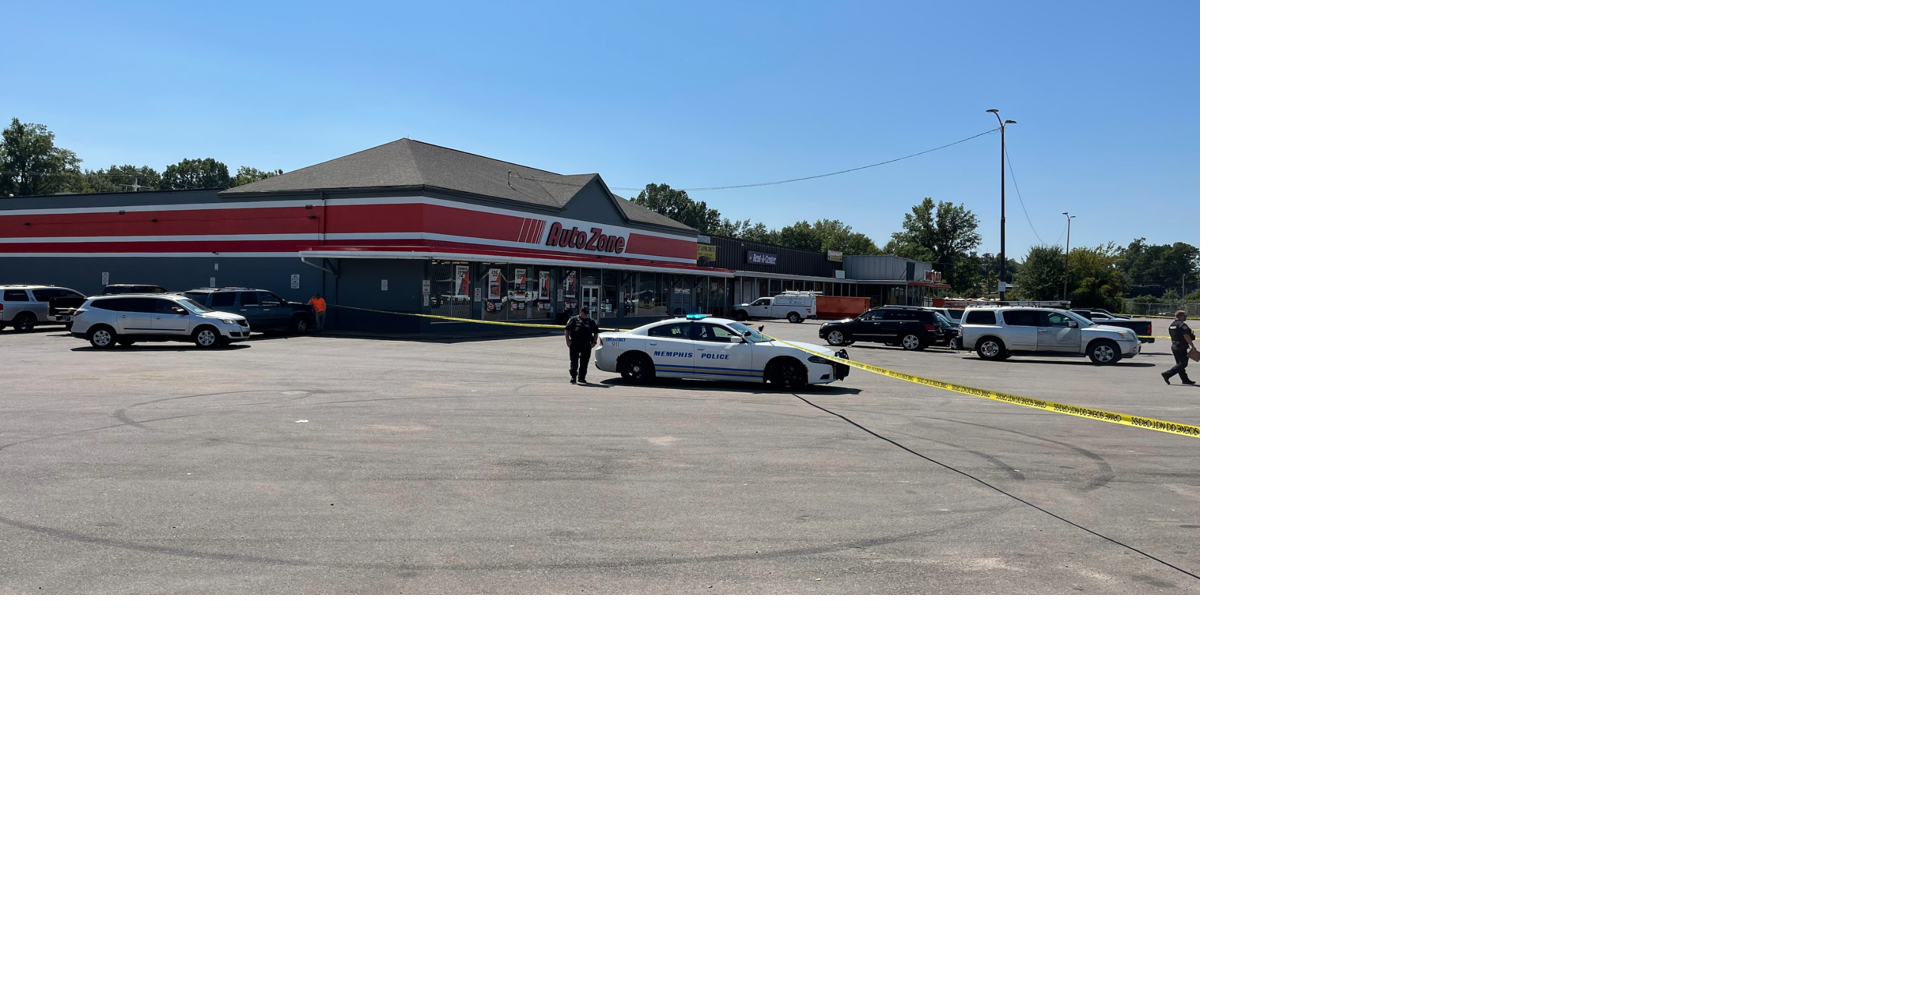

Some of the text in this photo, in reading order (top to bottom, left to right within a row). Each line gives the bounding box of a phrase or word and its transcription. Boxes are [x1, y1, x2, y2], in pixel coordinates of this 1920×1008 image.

[545, 221, 626, 254] AutoZone
[653, 350, 730, 360] MEMPHIS POLICE
